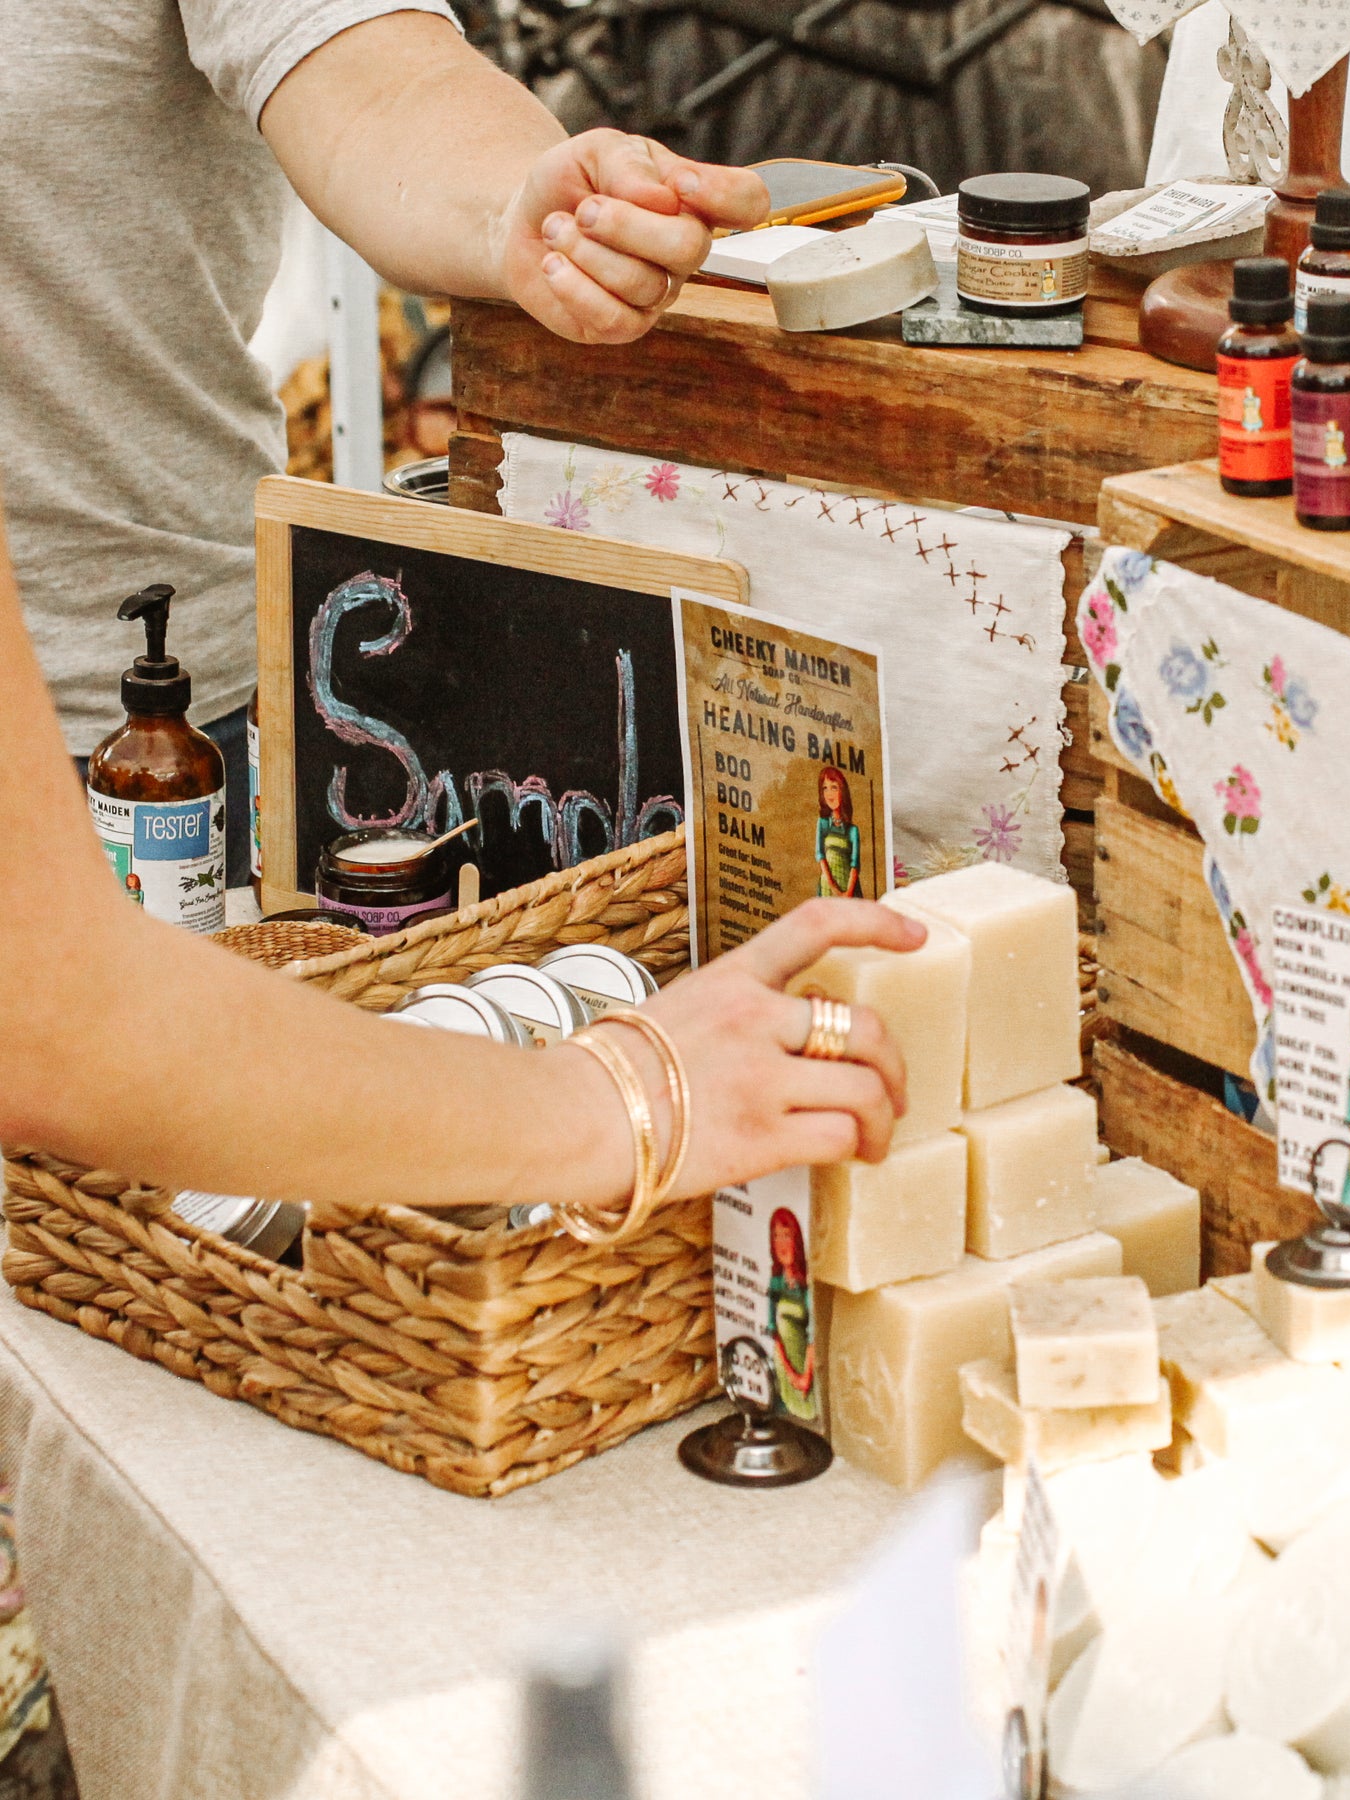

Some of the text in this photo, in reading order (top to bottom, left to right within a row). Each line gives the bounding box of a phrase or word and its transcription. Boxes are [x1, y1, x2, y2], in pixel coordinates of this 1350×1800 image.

[990, 265, 1039, 277] Cookie
[711, 625, 851, 688] CHEEKY MAIDEN
[762, 664, 785, 680] SOAP
[711, 673, 734, 695] All
[703, 700, 865, 776] HEALING BALM
[715, 750, 751, 782] BOO
[716, 781, 752, 813] BOO
[97, 800, 130, 818] MAIDEN
[718, 811, 765, 848] BALM
[718, 843, 737, 859] Great
[752, 906, 761, 917] or
[580, 994, 609, 1009] MAIDEN
